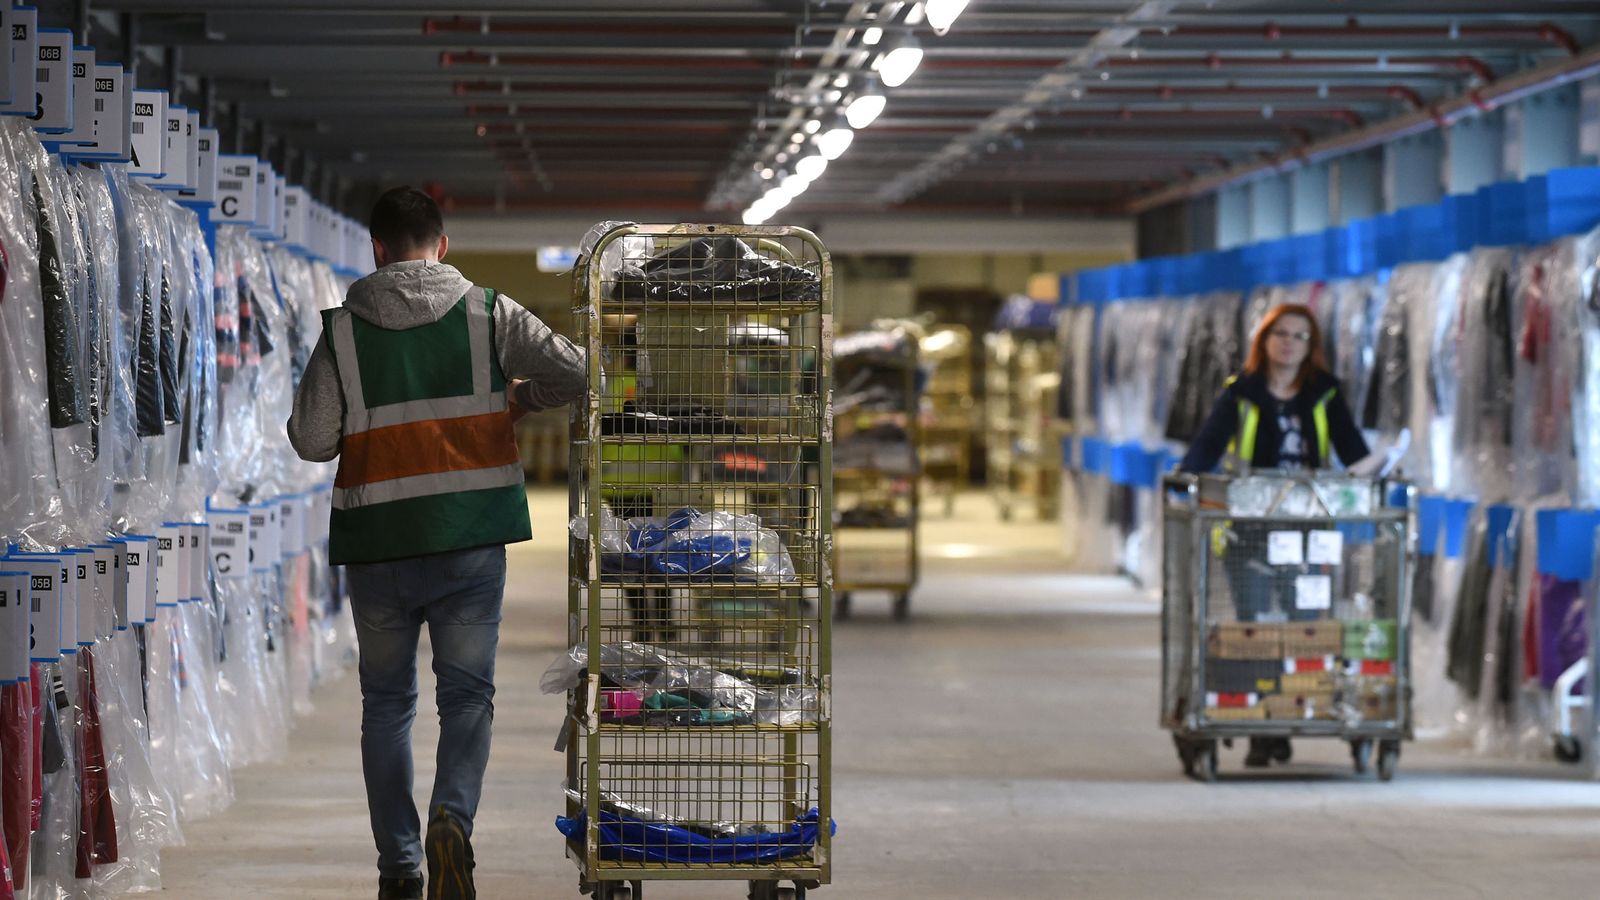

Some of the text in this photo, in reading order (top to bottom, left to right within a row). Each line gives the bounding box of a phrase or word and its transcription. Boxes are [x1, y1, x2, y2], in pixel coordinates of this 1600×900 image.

[40, 48, 60, 59] 06B
[95, 81, 112, 91] 06E
[135, 104, 153, 115] 06A
[221, 196, 238, 217] C
[215, 552, 231, 573] C
[32, 578, 51, 588] 05B
